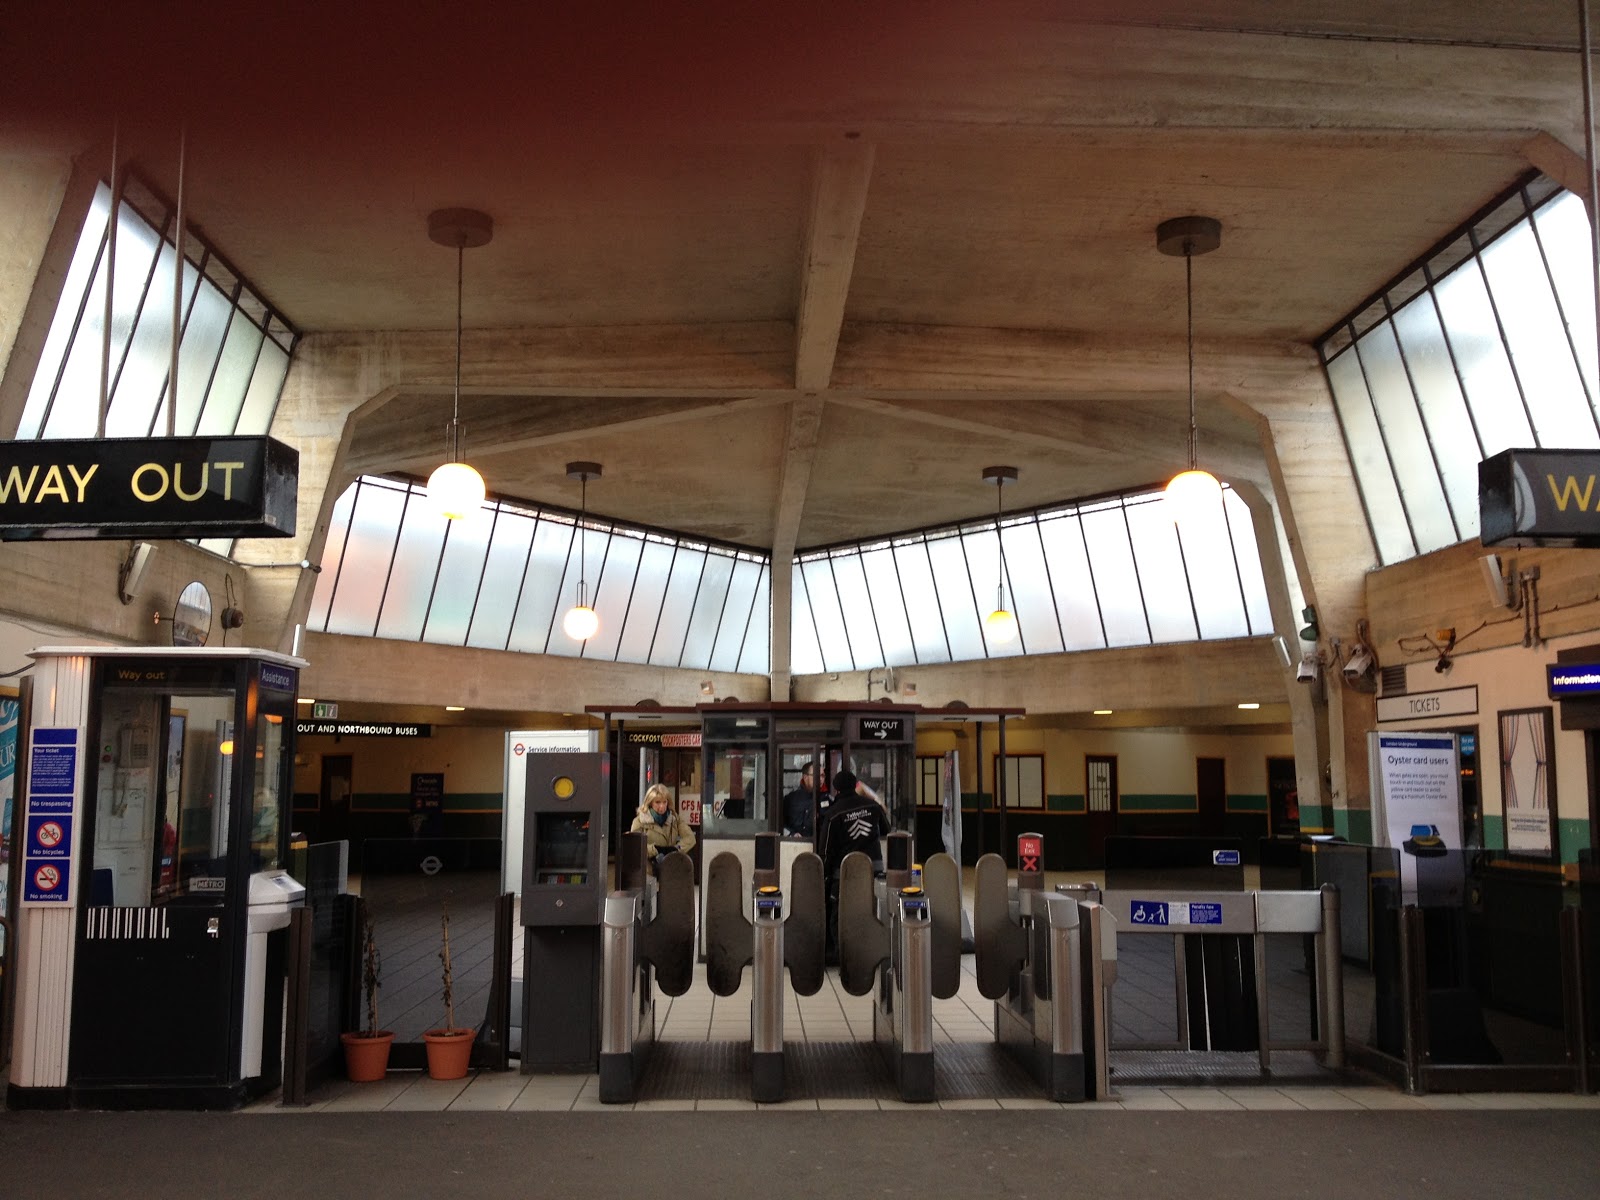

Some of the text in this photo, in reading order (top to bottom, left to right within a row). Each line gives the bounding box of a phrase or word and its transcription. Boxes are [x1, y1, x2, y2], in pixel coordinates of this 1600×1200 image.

[0, 462, 244, 504] WAY OUT
[1547, 474, 1600, 512] W
[118, 669, 166, 681] Way out
[261, 668, 290, 686] Assistance
[1553, 674, 1600, 686] Information
[1409, 697, 1440, 713] TICKETS
[297, 723, 418, 736] OUT AND NORTHBOUND BUSES
[863, 721, 899, 729] WAY OUT
[628, 733, 663, 743] COCKFOST
[1388, 755, 1449, 766] Oyster card users
[40, 800, 72, 808] trespassing
[681, 800, 695, 811] CFS
[42, 848, 65, 856] bicycles
